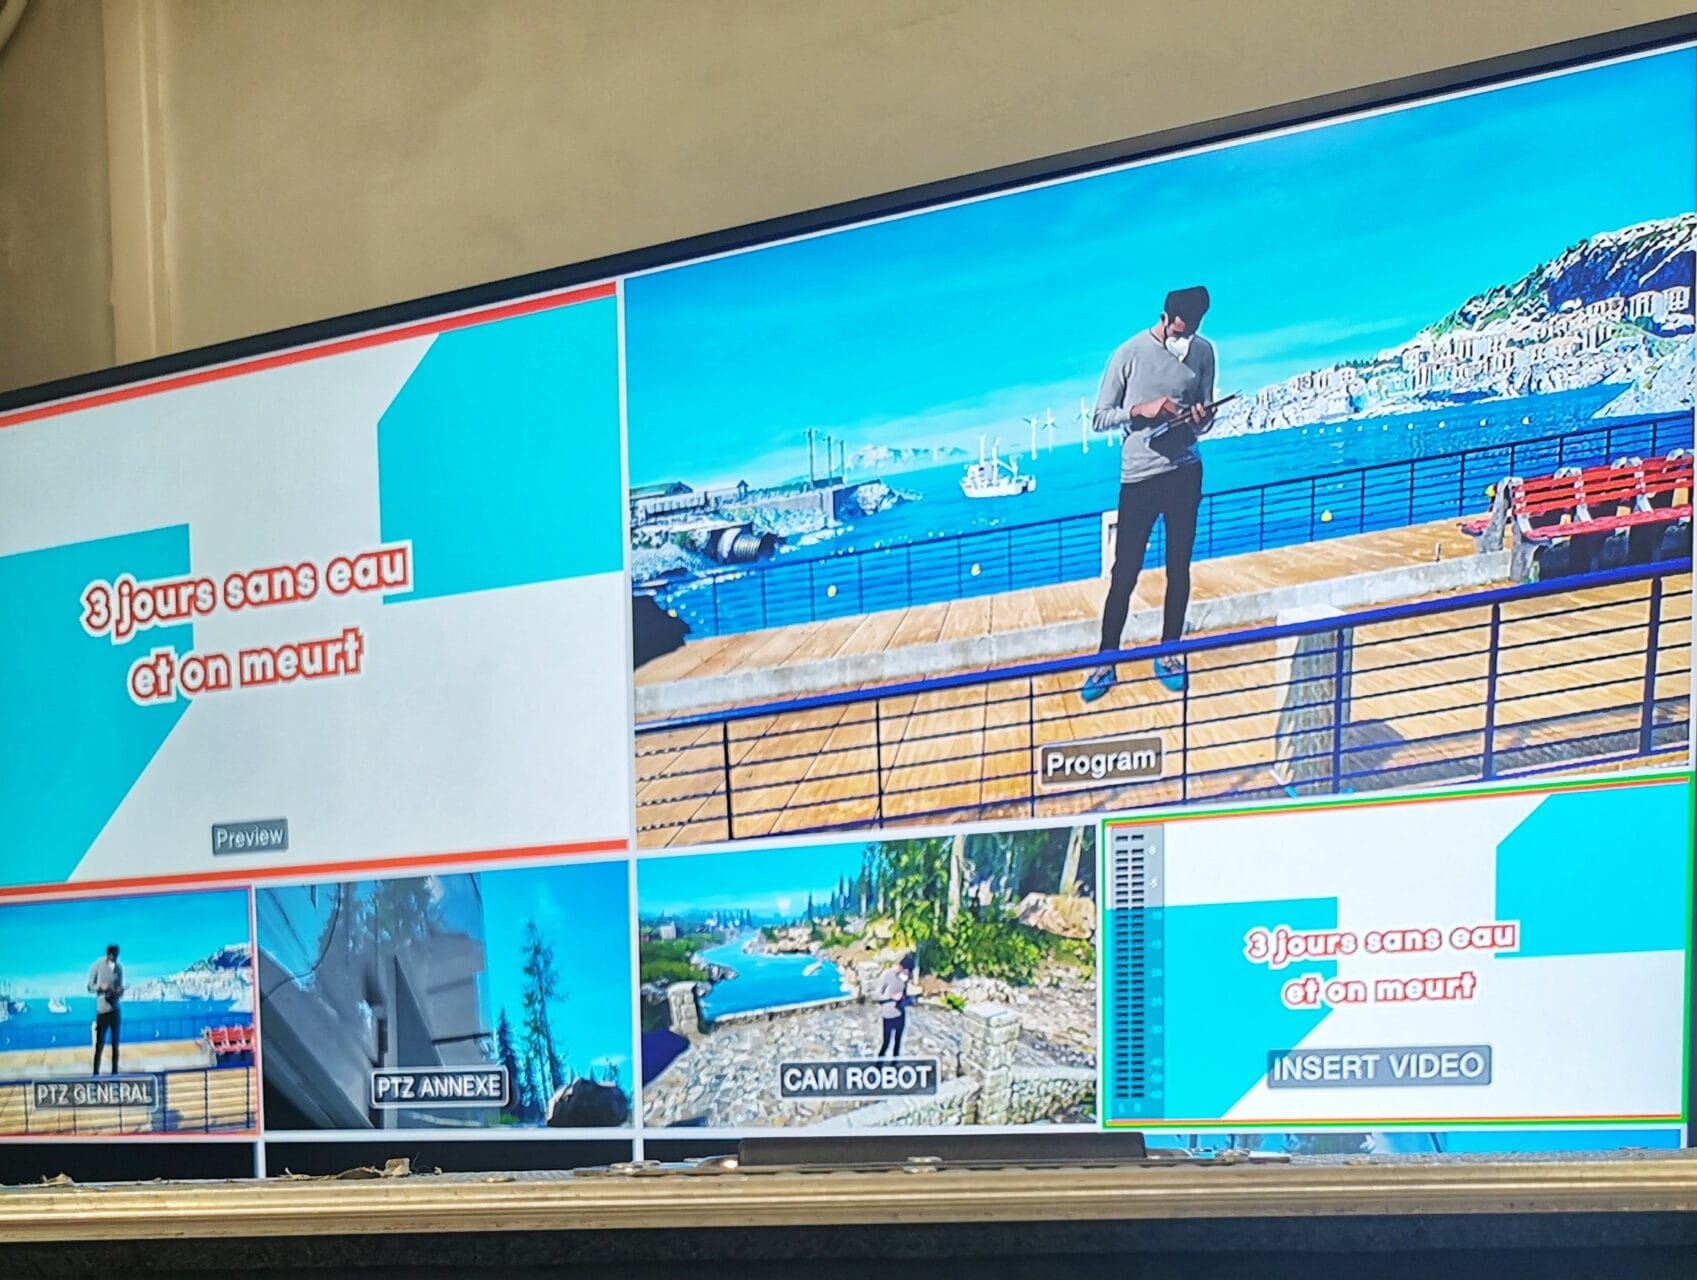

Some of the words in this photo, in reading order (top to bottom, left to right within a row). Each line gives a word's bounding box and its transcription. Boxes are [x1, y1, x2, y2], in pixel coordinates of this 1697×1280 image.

[85, 586, 111, 630] 3
[115, 578, 216, 637] jours
[223, 561, 317, 608] sans
[326, 547, 410, 590] eau
[131, 652, 173, 699] et
[180, 653, 230, 693] on
[239, 627, 362, 688] meurt
[1046, 750, 1157, 779] Program
[215, 825, 284, 850] Preview
[1248, 931, 1268, 959] 3
[1274, 929, 1357, 965] jours
[1364, 929, 1442, 953] sans
[1450, 925, 1516, 950] eau
[1285, 976, 1319, 1005] et
[1326, 978, 1367, 1003] on
[1375, 973, 1477, 1002] meurt
[783, 1065, 839, 1091] CAM
[846, 1062, 933, 1089] ROBOT
[1272, 1053, 1379, 1082] INSERT
[1389, 1049, 1485, 1079] VIDEO
[37, 1082, 69, 1105] PTZ
[74, 1080, 152, 1105] GENERAL
[377, 1077, 415, 1099] PTZ
[418, 1074, 501, 1097] ANNEXE
